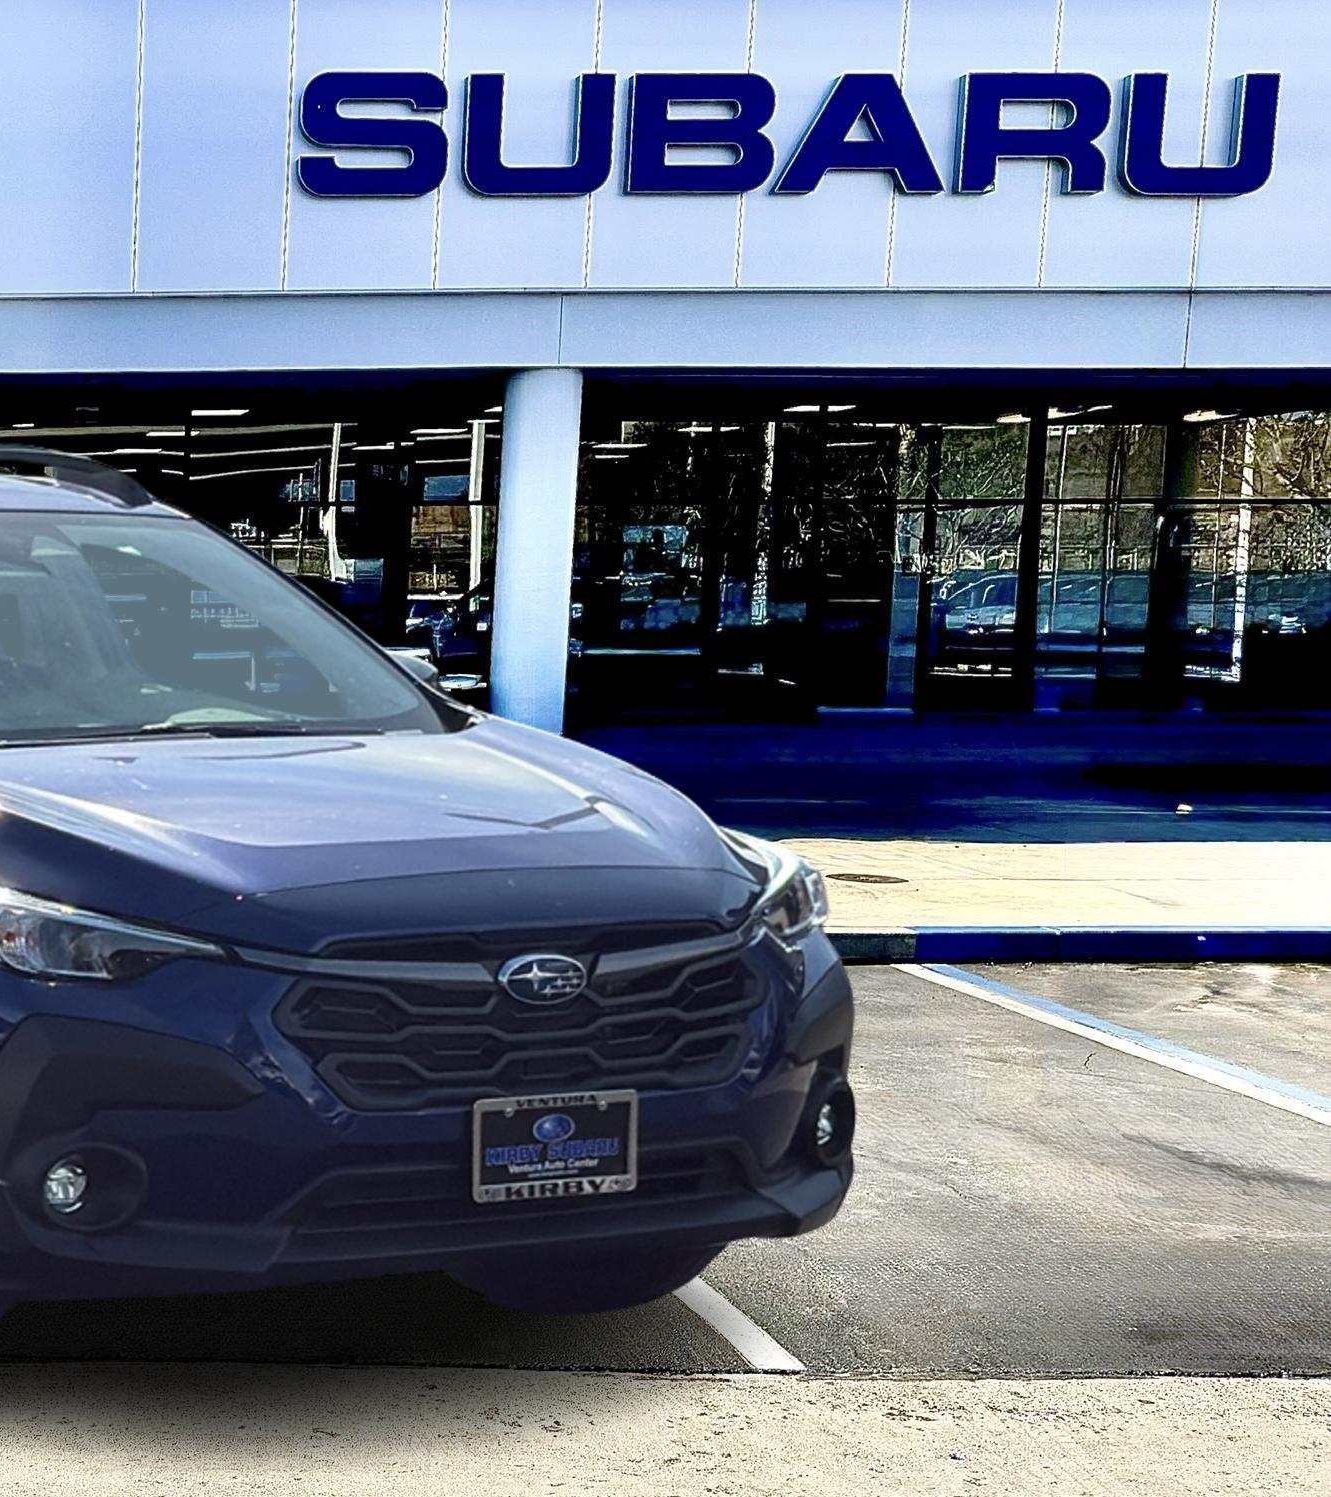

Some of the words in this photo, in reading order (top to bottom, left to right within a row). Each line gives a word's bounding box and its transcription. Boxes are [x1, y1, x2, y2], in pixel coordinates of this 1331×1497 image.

[296, 71, 1281, 197] SUBARU
[516, 1094, 597, 1108] VENTURA
[485, 1143, 543, 1166] KIRBY
[547, 1137, 619, 1160] SUBARU
[508, 1161, 541, 1175] Ventura
[544, 1160, 565, 1171] Auto
[569, 1157, 599, 1168] Center
[504, 1178, 605, 1199] KIRBY
